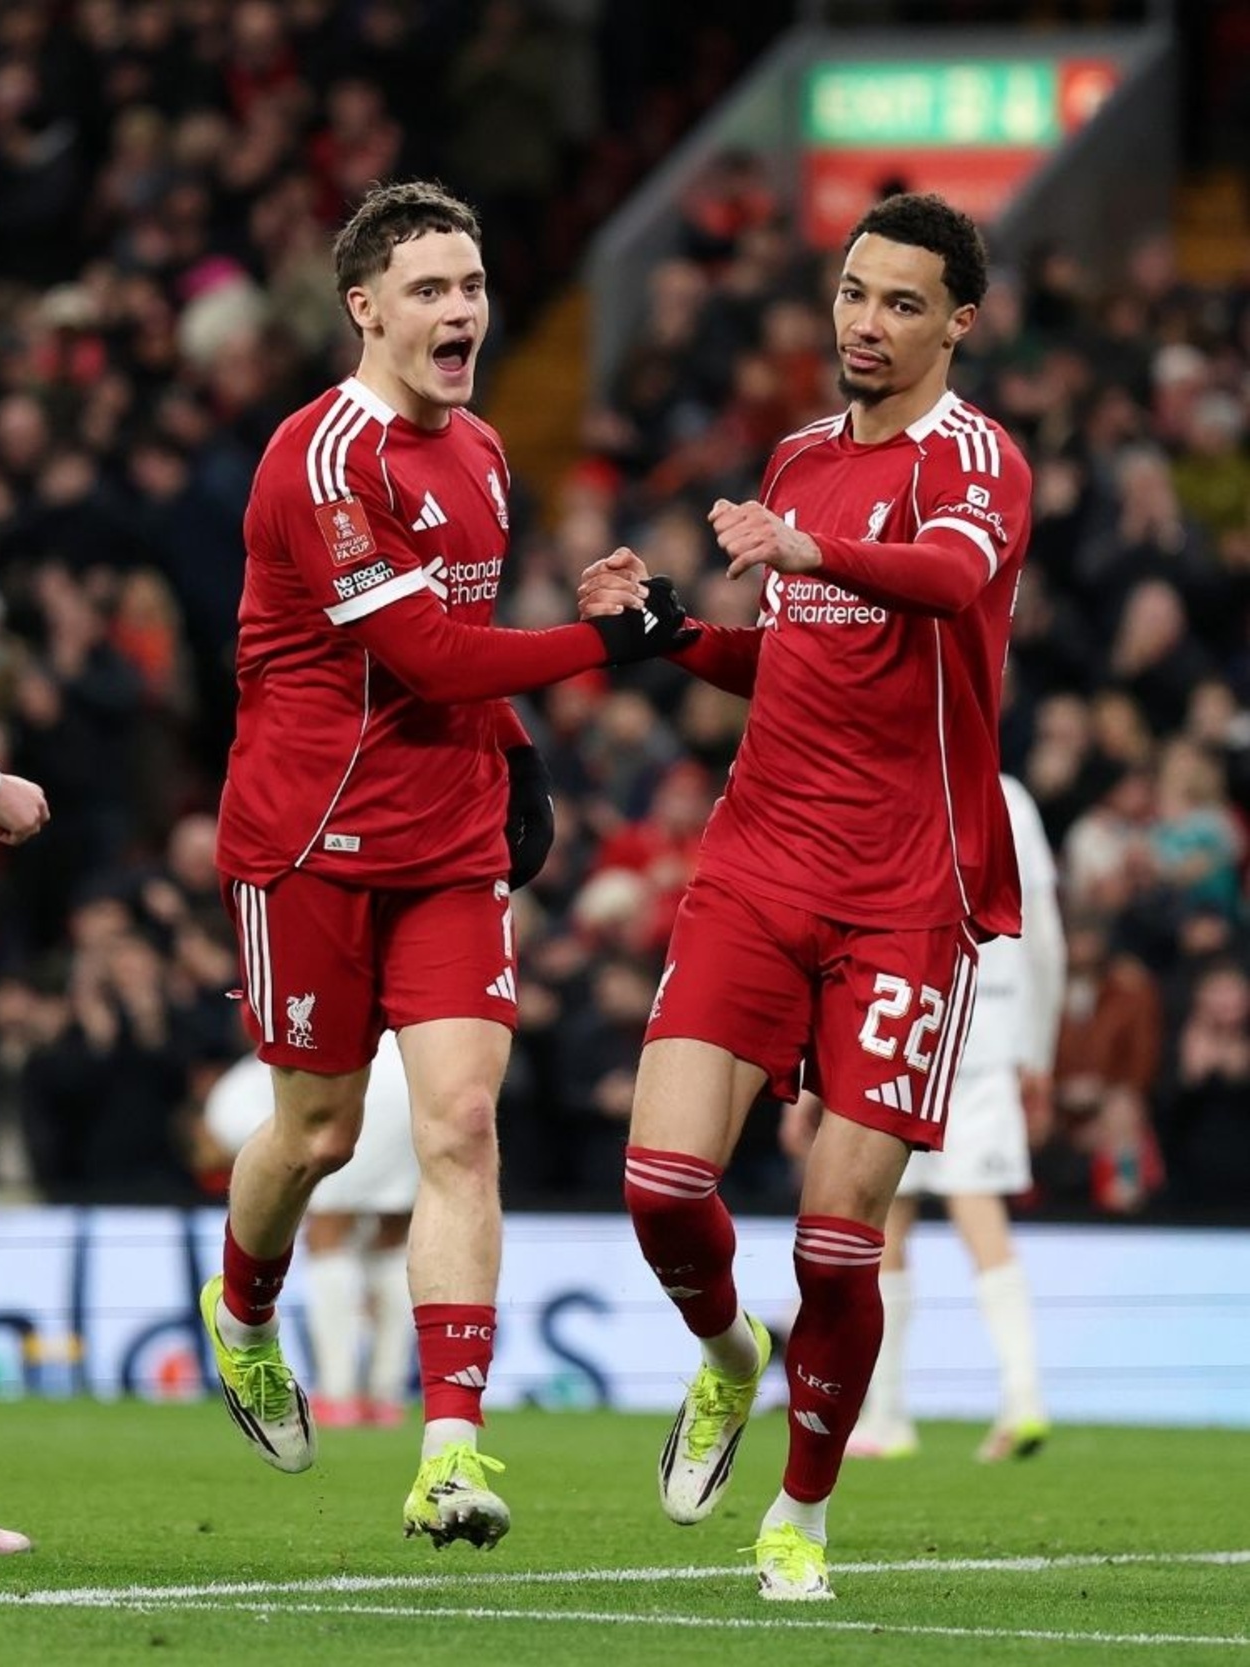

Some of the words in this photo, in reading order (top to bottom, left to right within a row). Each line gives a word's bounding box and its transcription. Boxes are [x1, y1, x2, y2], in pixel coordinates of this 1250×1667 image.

[336, 549, 350, 560] FA
[350, 541, 370, 556] CUP
[333, 577, 352, 588] No
[353, 561, 386, 582] room
[356, 568, 394, 592] racism
[450, 556, 504, 583] stand
[858, 972, 945, 1073] 22
[446, 1324, 491, 1341] LFC
[797, 1364, 841, 1394] LFC
